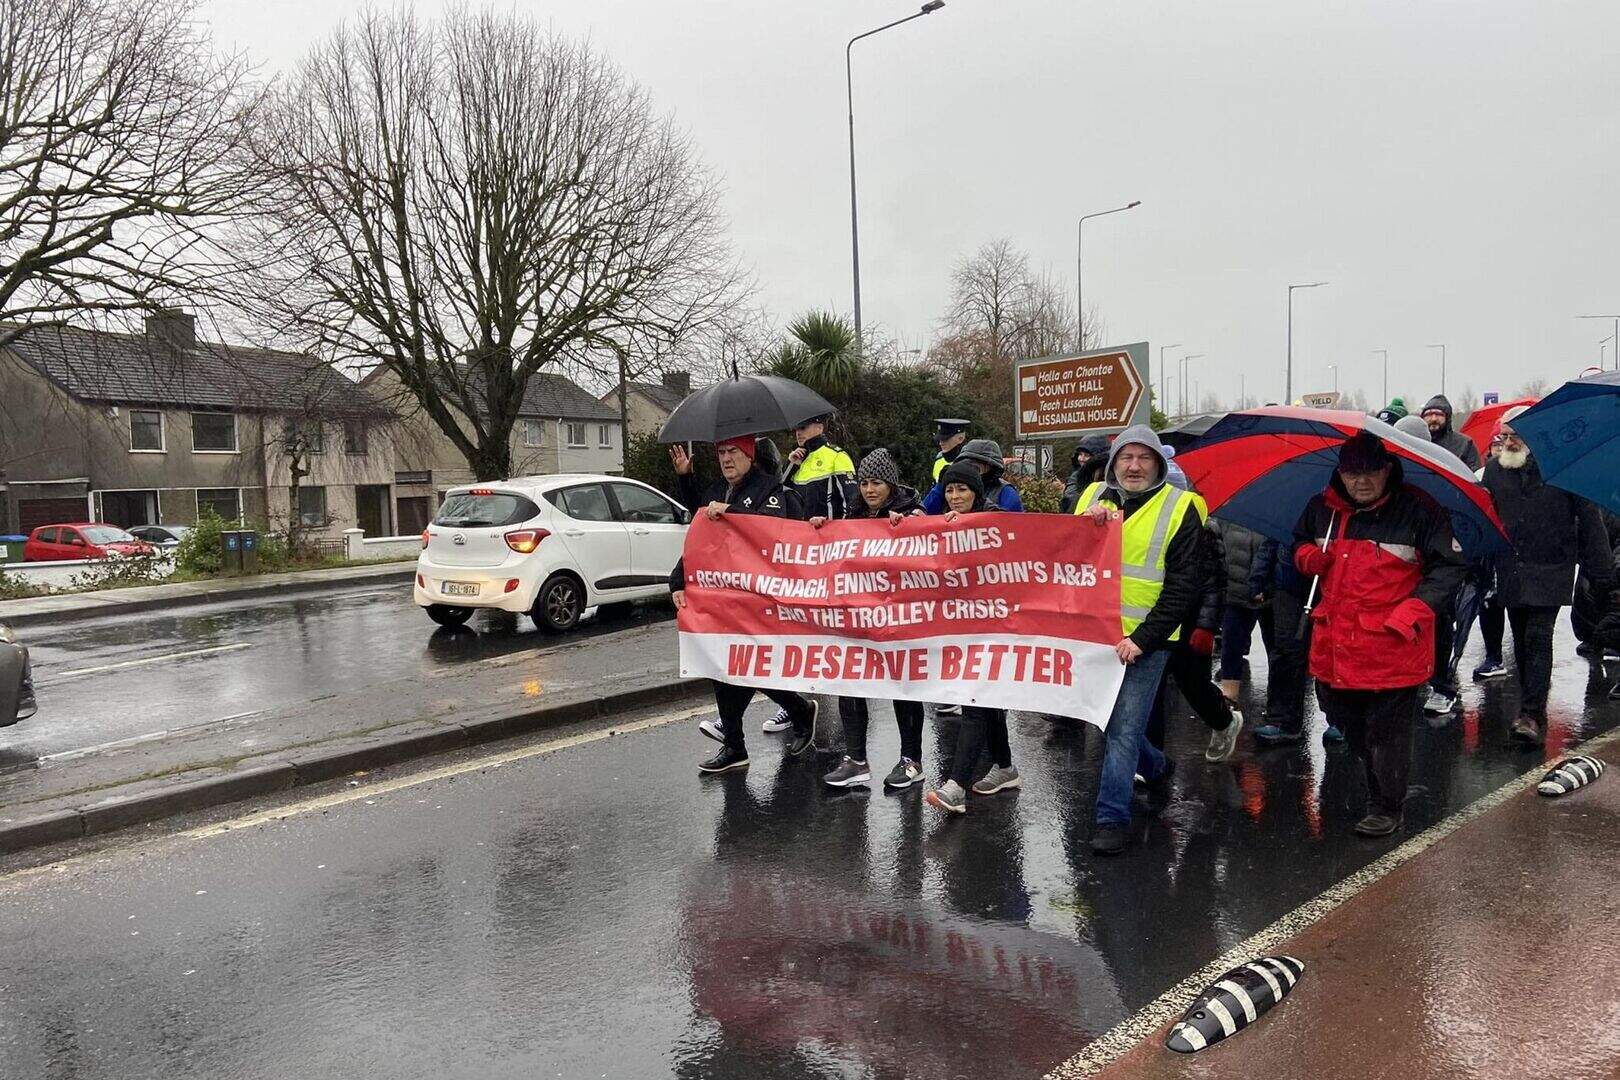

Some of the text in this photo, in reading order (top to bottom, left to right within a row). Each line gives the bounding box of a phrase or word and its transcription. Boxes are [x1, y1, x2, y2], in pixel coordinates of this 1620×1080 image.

[1038, 364, 1113, 383] Halla an Chontae
[1038, 379, 1104, 397] COUNTY HALL
[1040, 395, 1103, 412] Teach Lissanalta
[1311, 397, 1332, 405] YIELD
[1038, 408, 1118, 426] LISSANALTA HOUSE
[772, 526, 1003, 566] ALLEVIATE WAITING TIMES
[696, 569, 752, 592] REOPEN
[755, 574, 830, 600] NENAGH,
[834, 570, 896, 595] ENNIS,
[900, 570, 940, 590] AND
[943, 567, 969, 587] ST
[976, 560, 1048, 586] JOHN'S
[776, 598, 1009, 629] END THE TROLLEY CRISIS
[727, 644, 1073, 687] WE DESERVE BETTER
